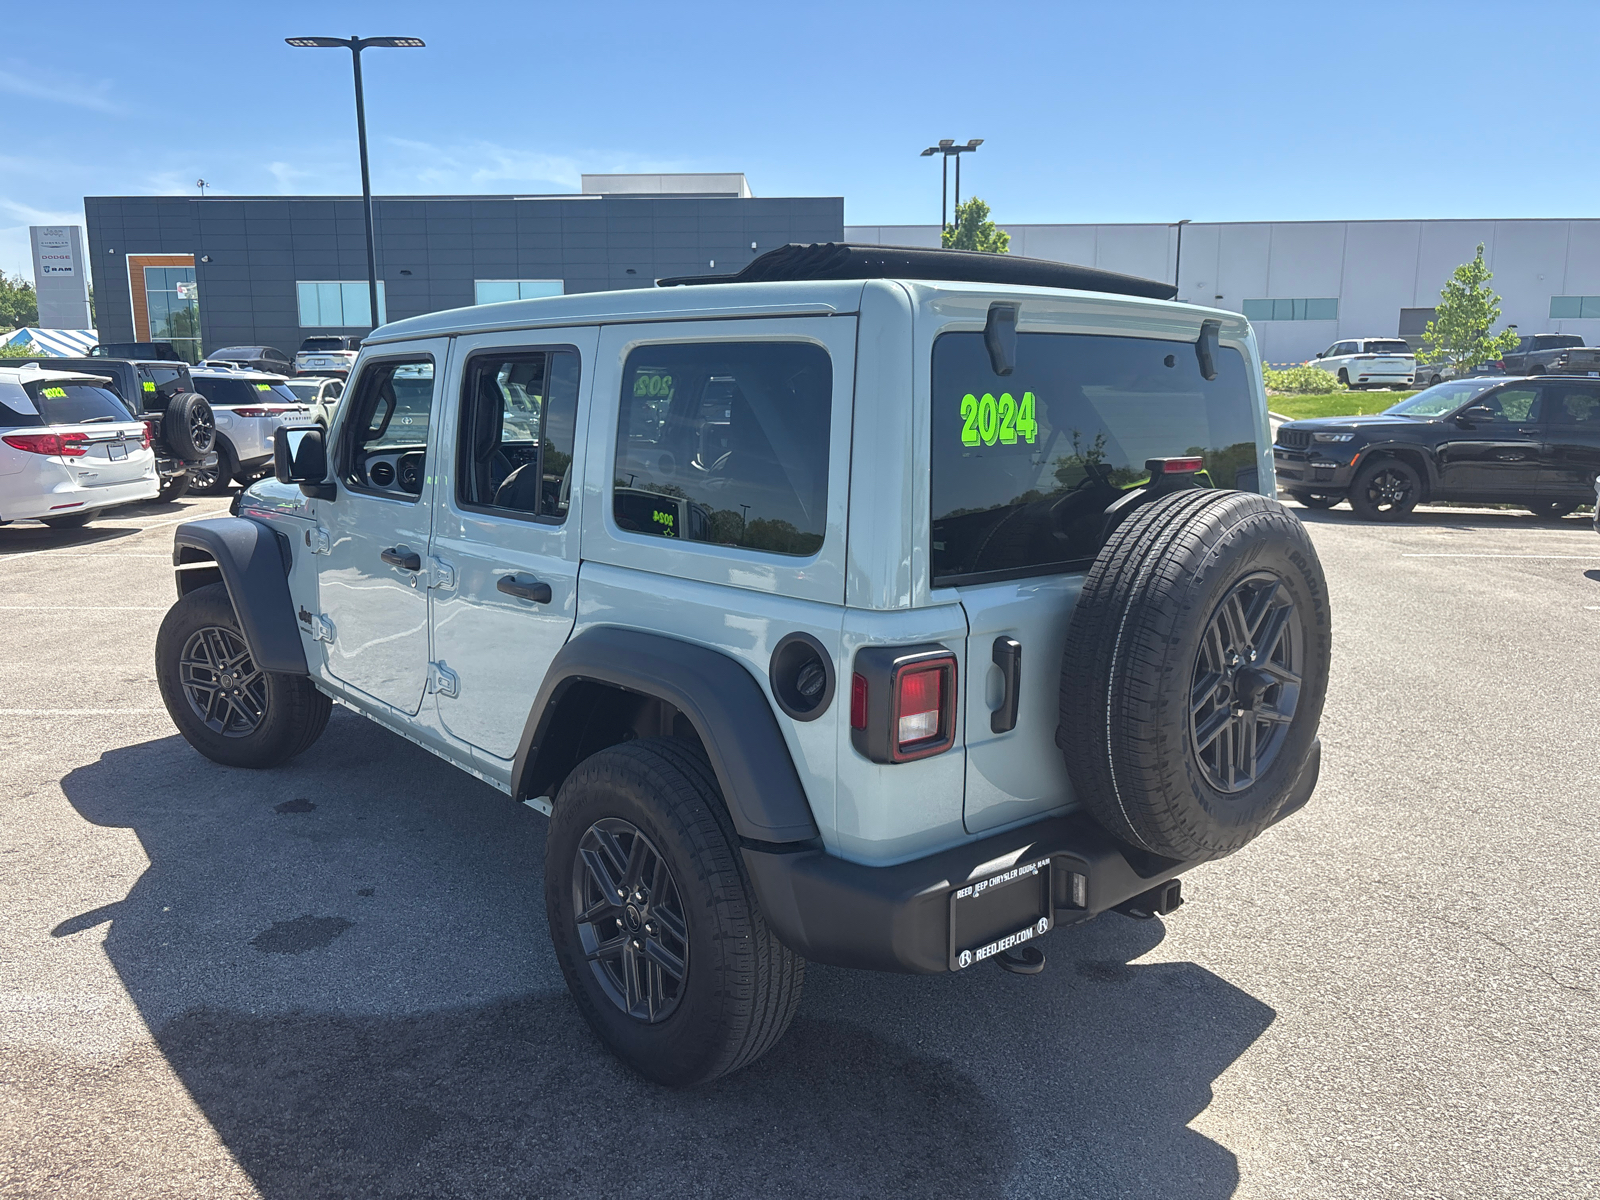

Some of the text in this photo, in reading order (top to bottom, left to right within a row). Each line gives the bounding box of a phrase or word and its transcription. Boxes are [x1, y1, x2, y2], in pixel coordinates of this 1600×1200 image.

[960, 391, 1038, 447] 2024
[957, 857, 1051, 900] REED JEEP CHRYSLER DODGE RAM
[976, 928, 1033, 962] REEDJEEP.COM
